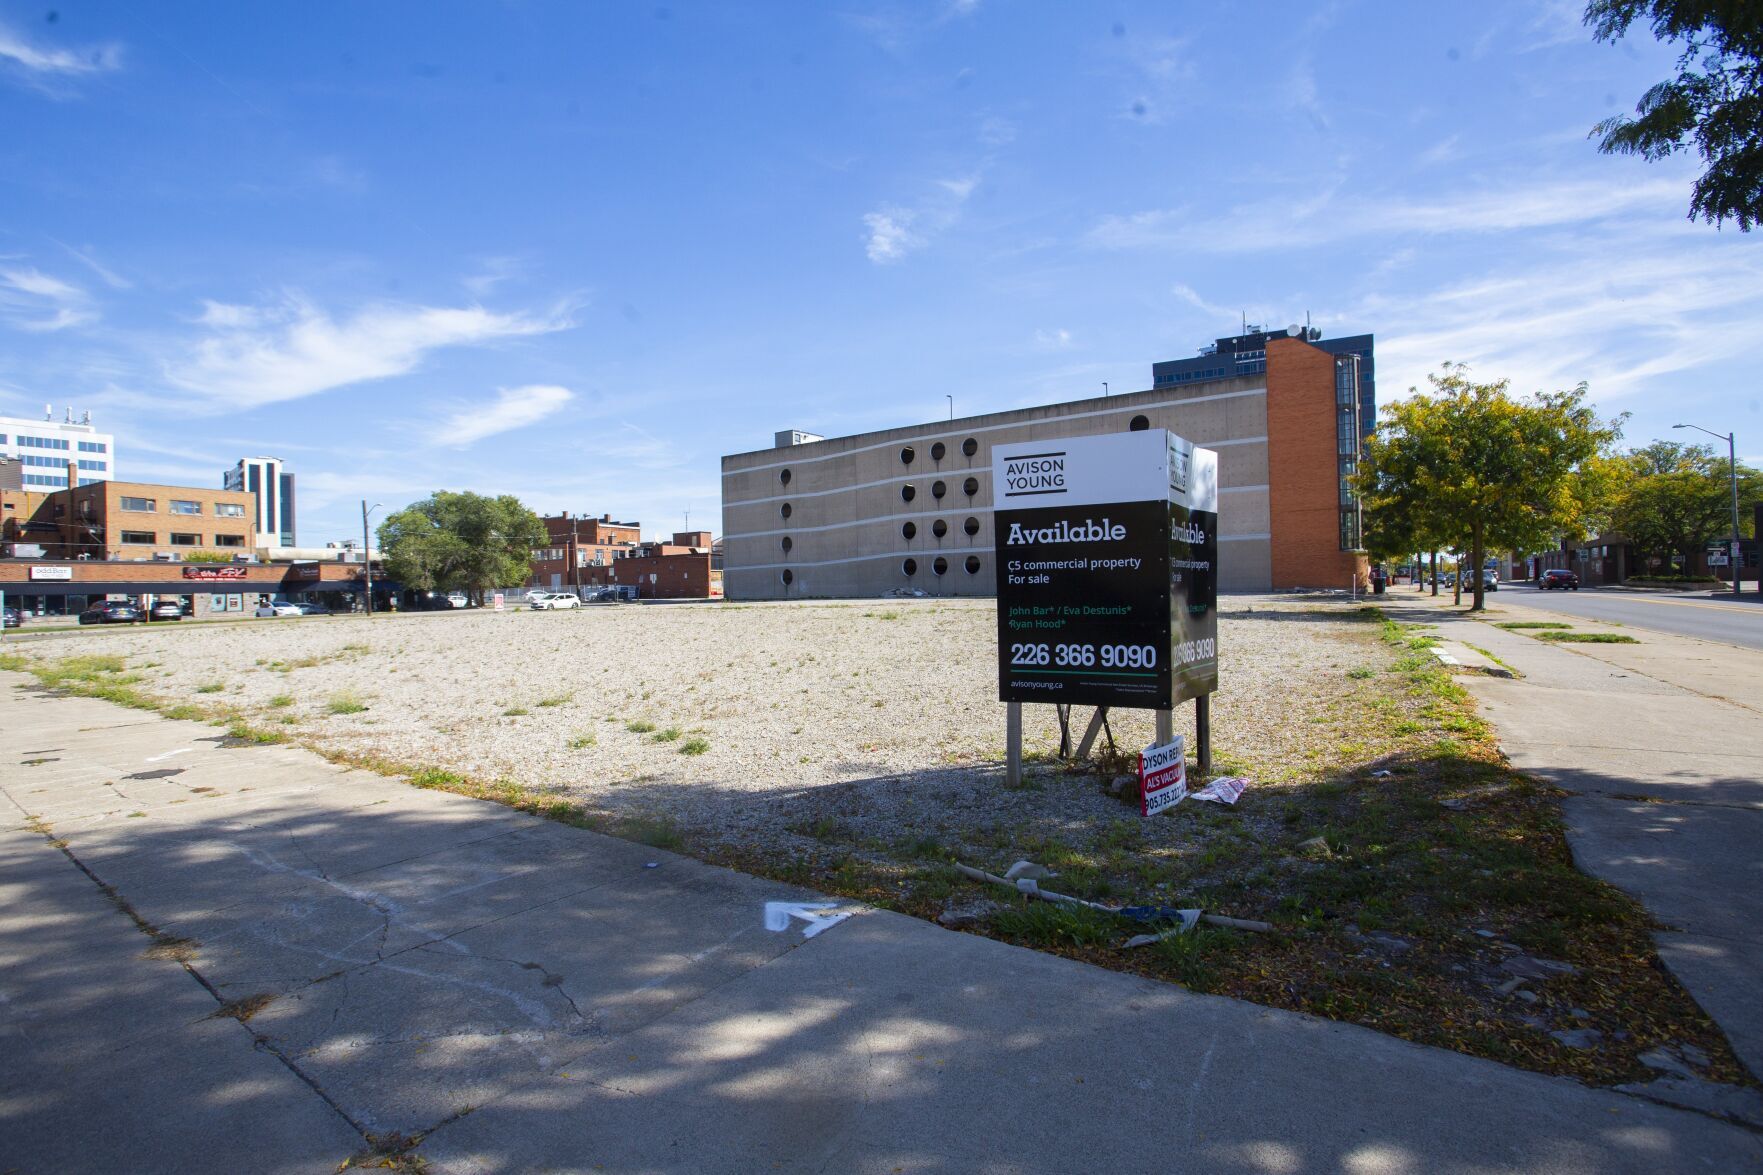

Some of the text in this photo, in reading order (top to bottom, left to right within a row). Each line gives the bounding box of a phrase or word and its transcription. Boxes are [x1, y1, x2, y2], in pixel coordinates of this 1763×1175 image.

[1006, 459, 1064, 476] AVISON
[1007, 474, 1065, 490] YOUNG
[1007, 518, 1127, 545] Available
[1007, 557, 1141, 571] C5 commercial property
[1008, 573, 1050, 585] For sale
[1009, 605, 1031, 617] John
[1063, 606, 1081, 616] Eva
[1010, 620, 1033, 631] Ryan
[1010, 643, 1157, 669] 226 366 9090
[1196, 637, 1215, 660] 9090
[1010, 680, 1063, 690] avisonyoung.ca
[1142, 751, 1168, 771] DYSON
[1146, 768, 1181, 790] AL'S VACUU
